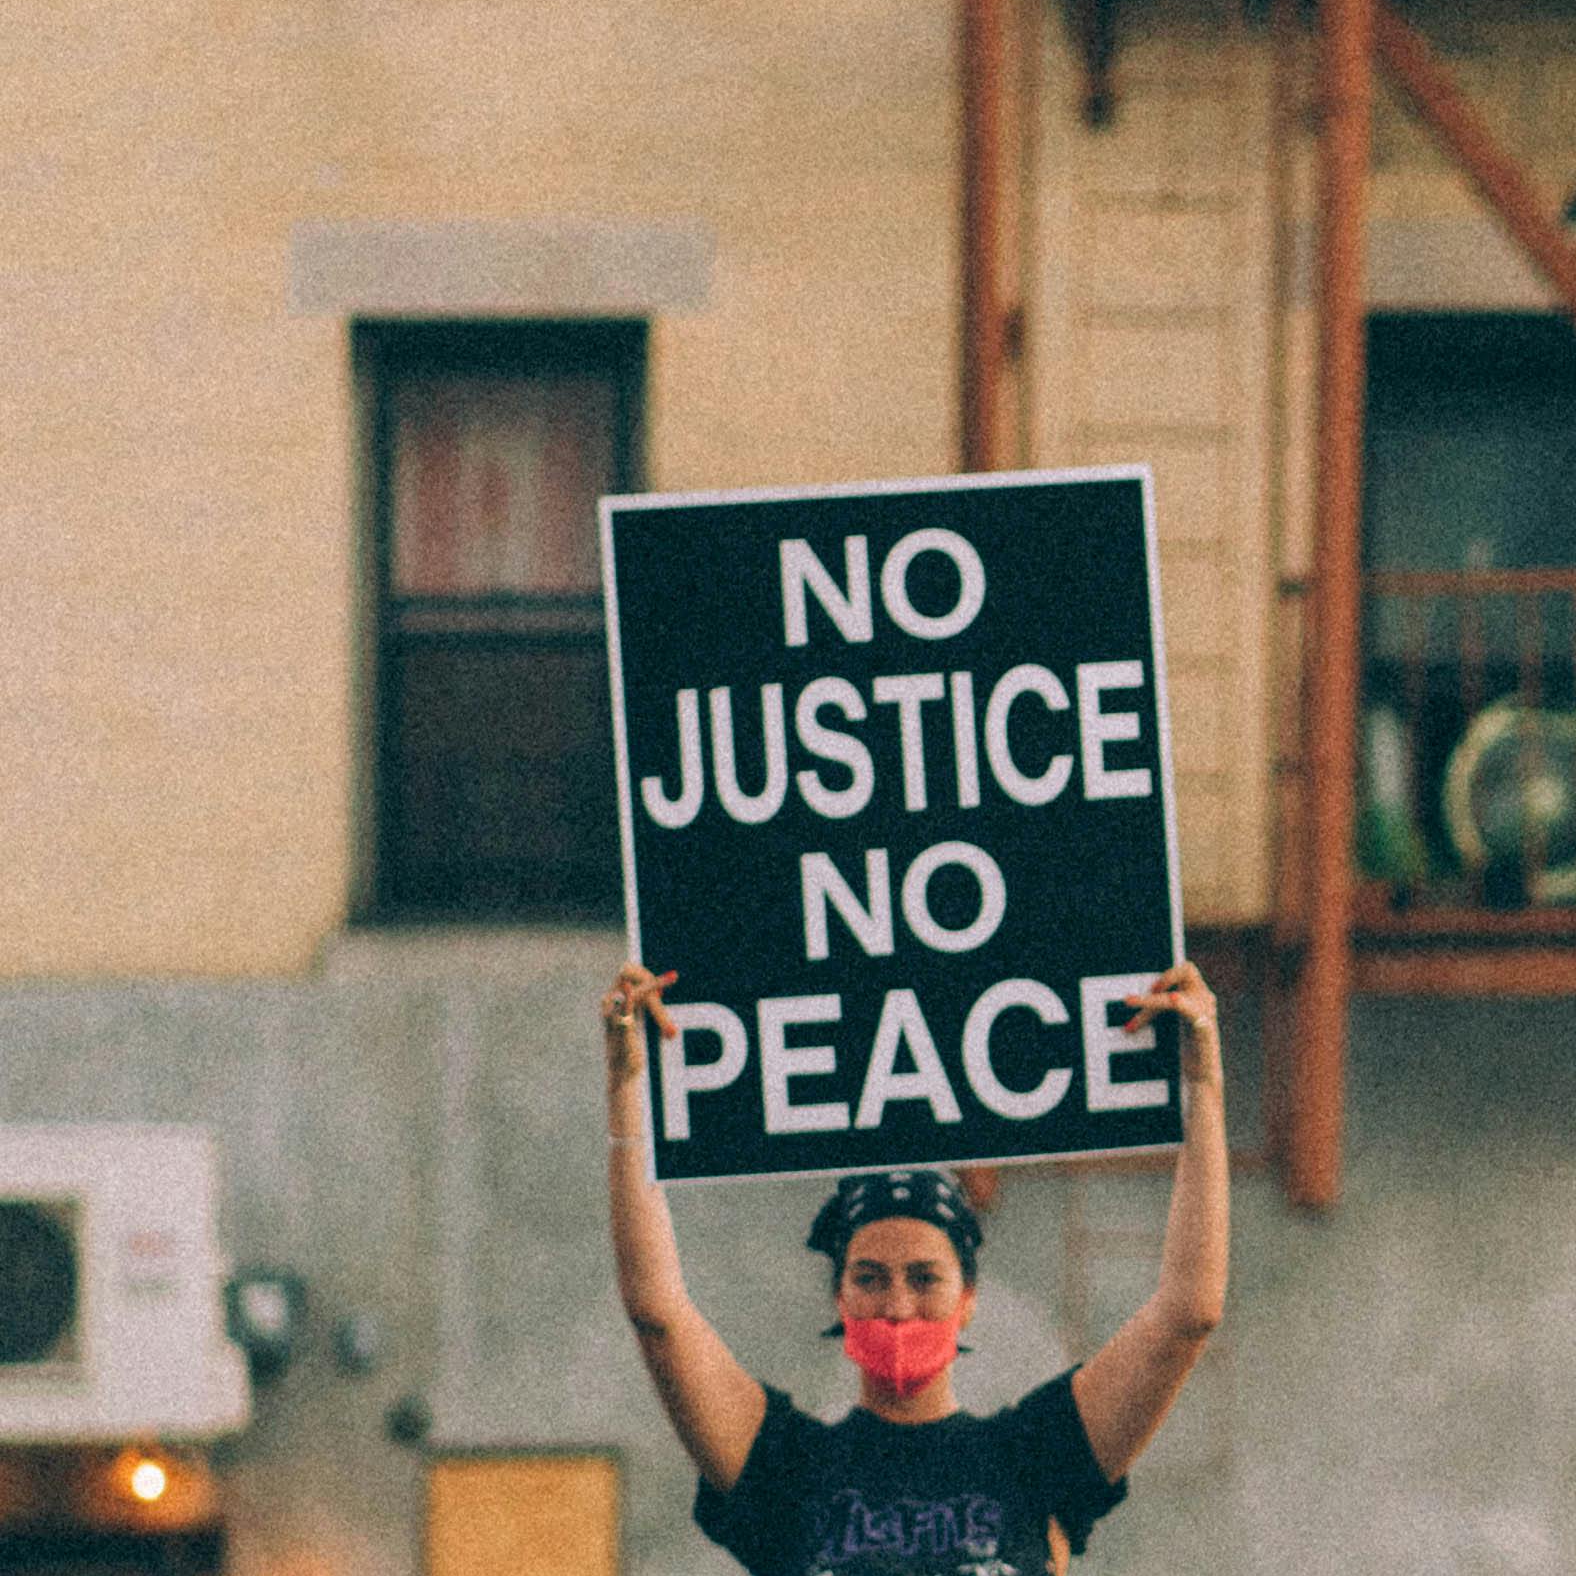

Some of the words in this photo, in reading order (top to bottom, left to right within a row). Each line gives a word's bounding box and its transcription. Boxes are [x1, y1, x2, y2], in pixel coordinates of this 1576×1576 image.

[781, 528, 985, 646] NO
[641, 660, 1152, 828] JUSTICE
[801, 841, 1006, 960] NO
[660, 972, 1170, 1140] PEACE
